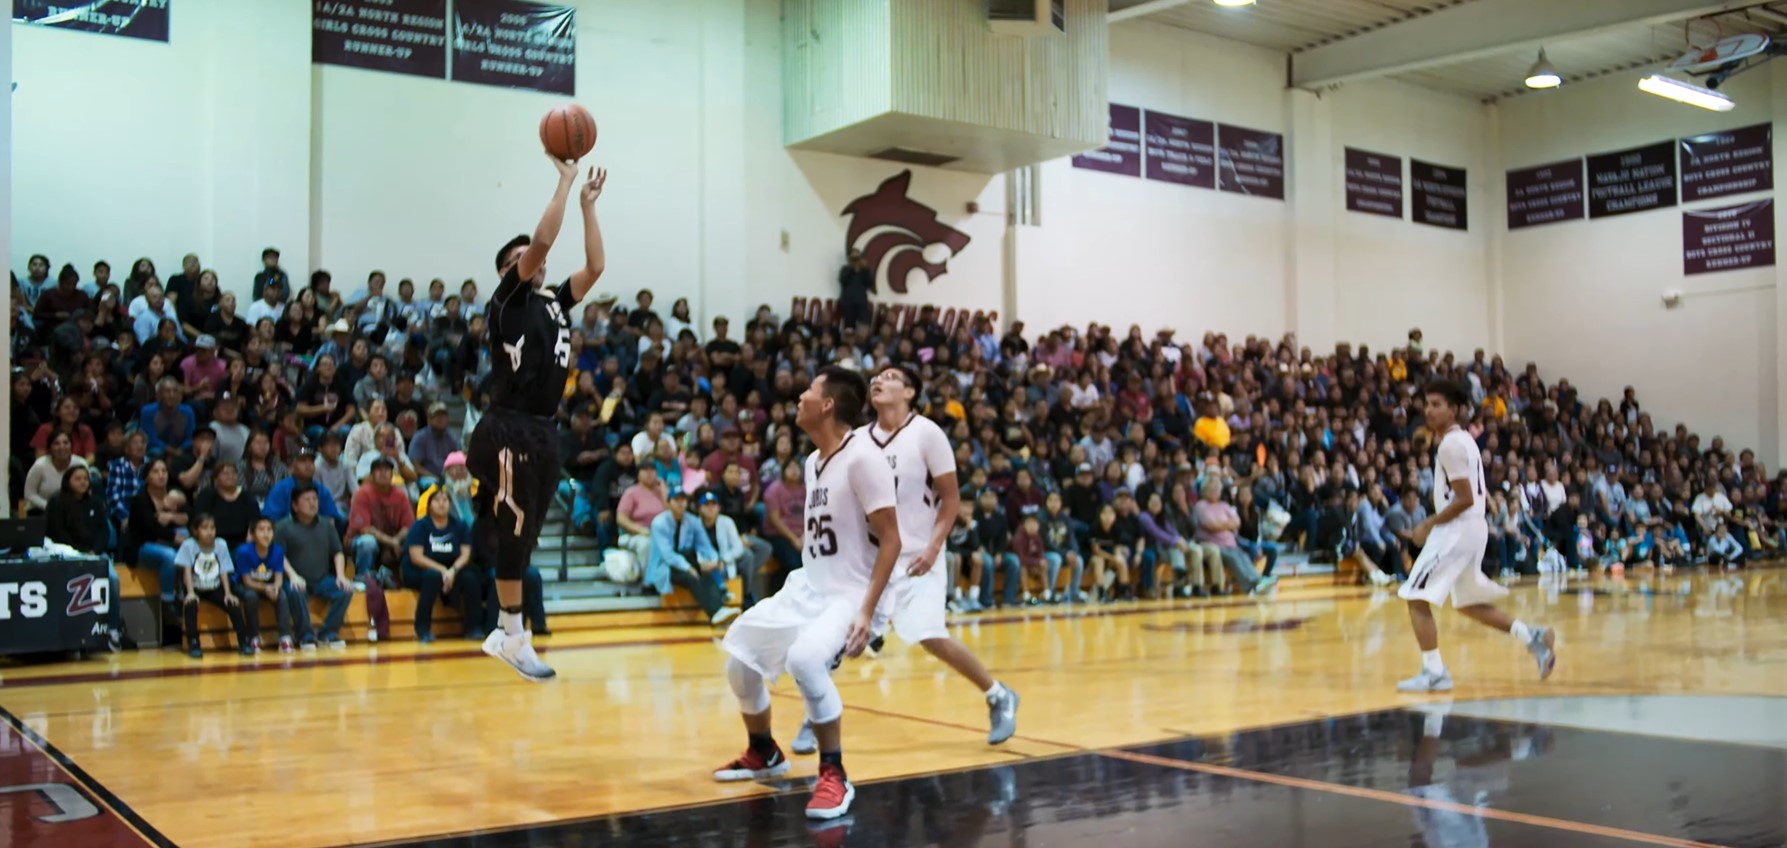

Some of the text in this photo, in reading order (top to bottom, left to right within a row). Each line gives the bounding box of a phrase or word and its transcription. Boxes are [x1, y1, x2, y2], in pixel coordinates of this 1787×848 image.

[358, 6, 399, 23] NORTH
[402, 13, 444, 30] REGION
[351, 23, 389, 39] CROSS
[391, 29, 445, 47] COUNTRY
[343, 39, 413, 59] RUNNER-UP
[480, 58, 544, 77] RUNNER-UP
